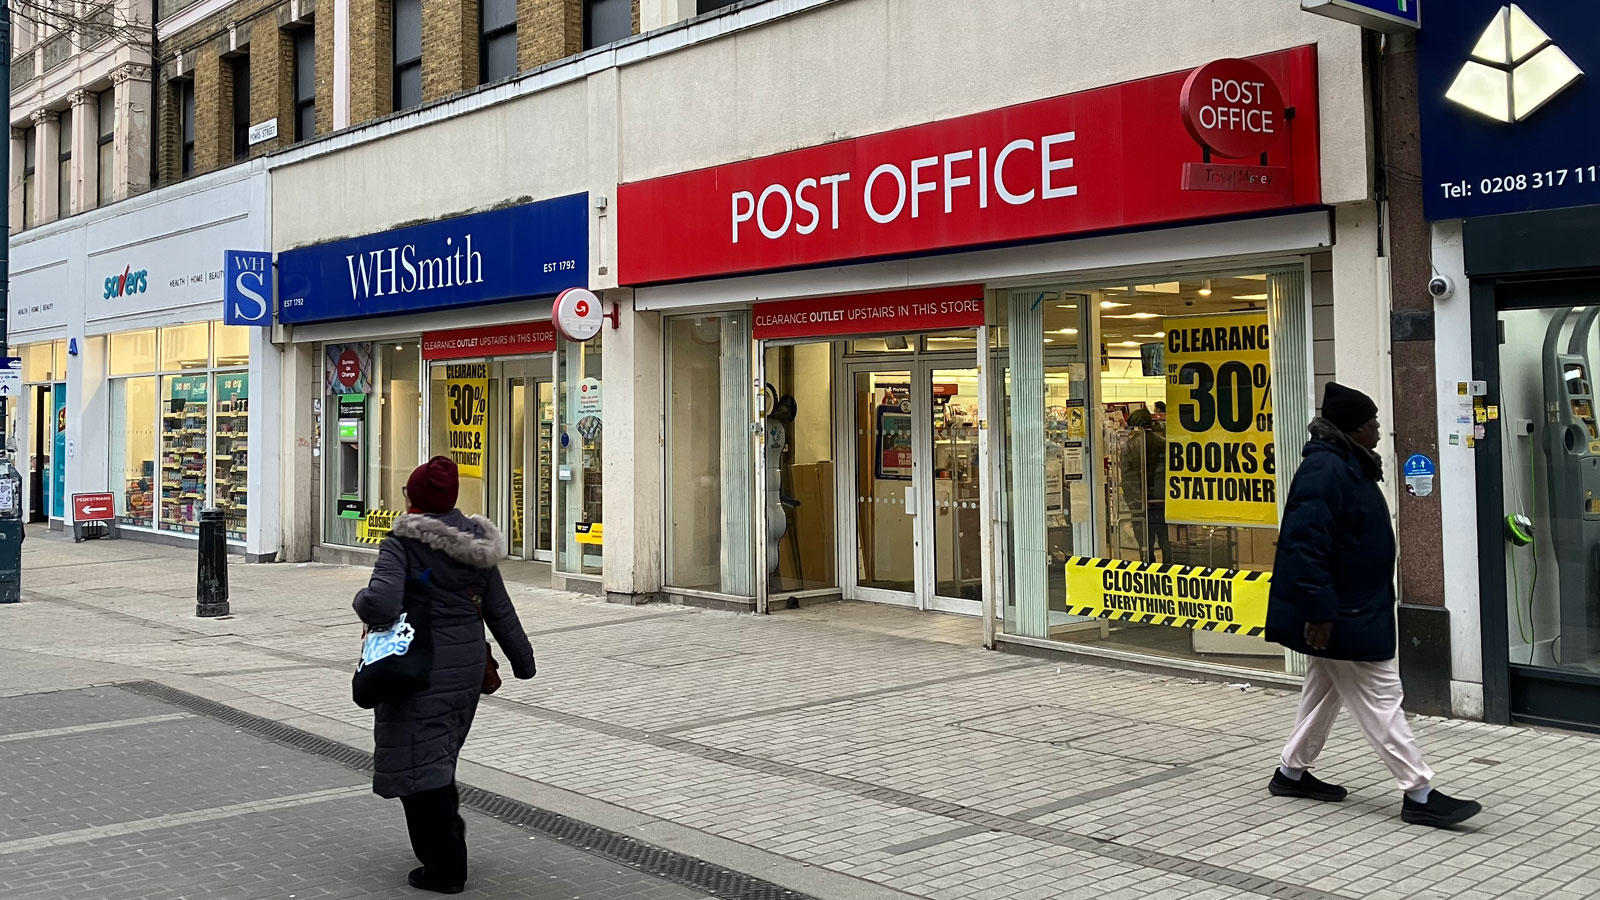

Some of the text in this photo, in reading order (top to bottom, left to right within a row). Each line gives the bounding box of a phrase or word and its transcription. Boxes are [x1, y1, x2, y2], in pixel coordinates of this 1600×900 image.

[1211, 78, 1265, 105] POST
[1199, 105, 1274, 133] OFFICE
[731, 131, 1078, 243] POST OFFICE
[1440, 164, 1600, 199] Tel: 0208 317 11
[234, 256, 267, 271] WH
[346, 233, 484, 300] WHSmith
[543, 259, 576, 273] EST 1792
[103, 264, 148, 299] savers
[169, 270, 224, 287] HEALTH HOME BEAUT
[234, 271, 267, 321] S
[283, 300, 293, 308] EST
[755, 300, 980, 327] CLEARANCE OUTLET UPSTAIRS IN THIS STORE
[423, 331, 554, 351] CLEARANCE OUTLET UPSTAIRS IN THIS STORE
[1168, 324, 1269, 353] CLEARANC
[446, 364, 486, 379] CLEARANCE
[1168, 363, 1178, 374] UP
[1168, 374, 1178, 384] TO
[473, 414, 484, 426] OFF
[1256, 413, 1272, 432] OF
[473, 431, 482, 450] &
[450, 451, 482, 466] TATIONERY
[1169, 441, 1258, 474] BOOKS
[1169, 476, 1276, 503] STATIONER
[368, 515, 391, 528] CLOSING
[1102, 569, 1232, 603] CLOSING DOWN
[1103, 593, 1233, 622] EVERYTHING MUST GO
